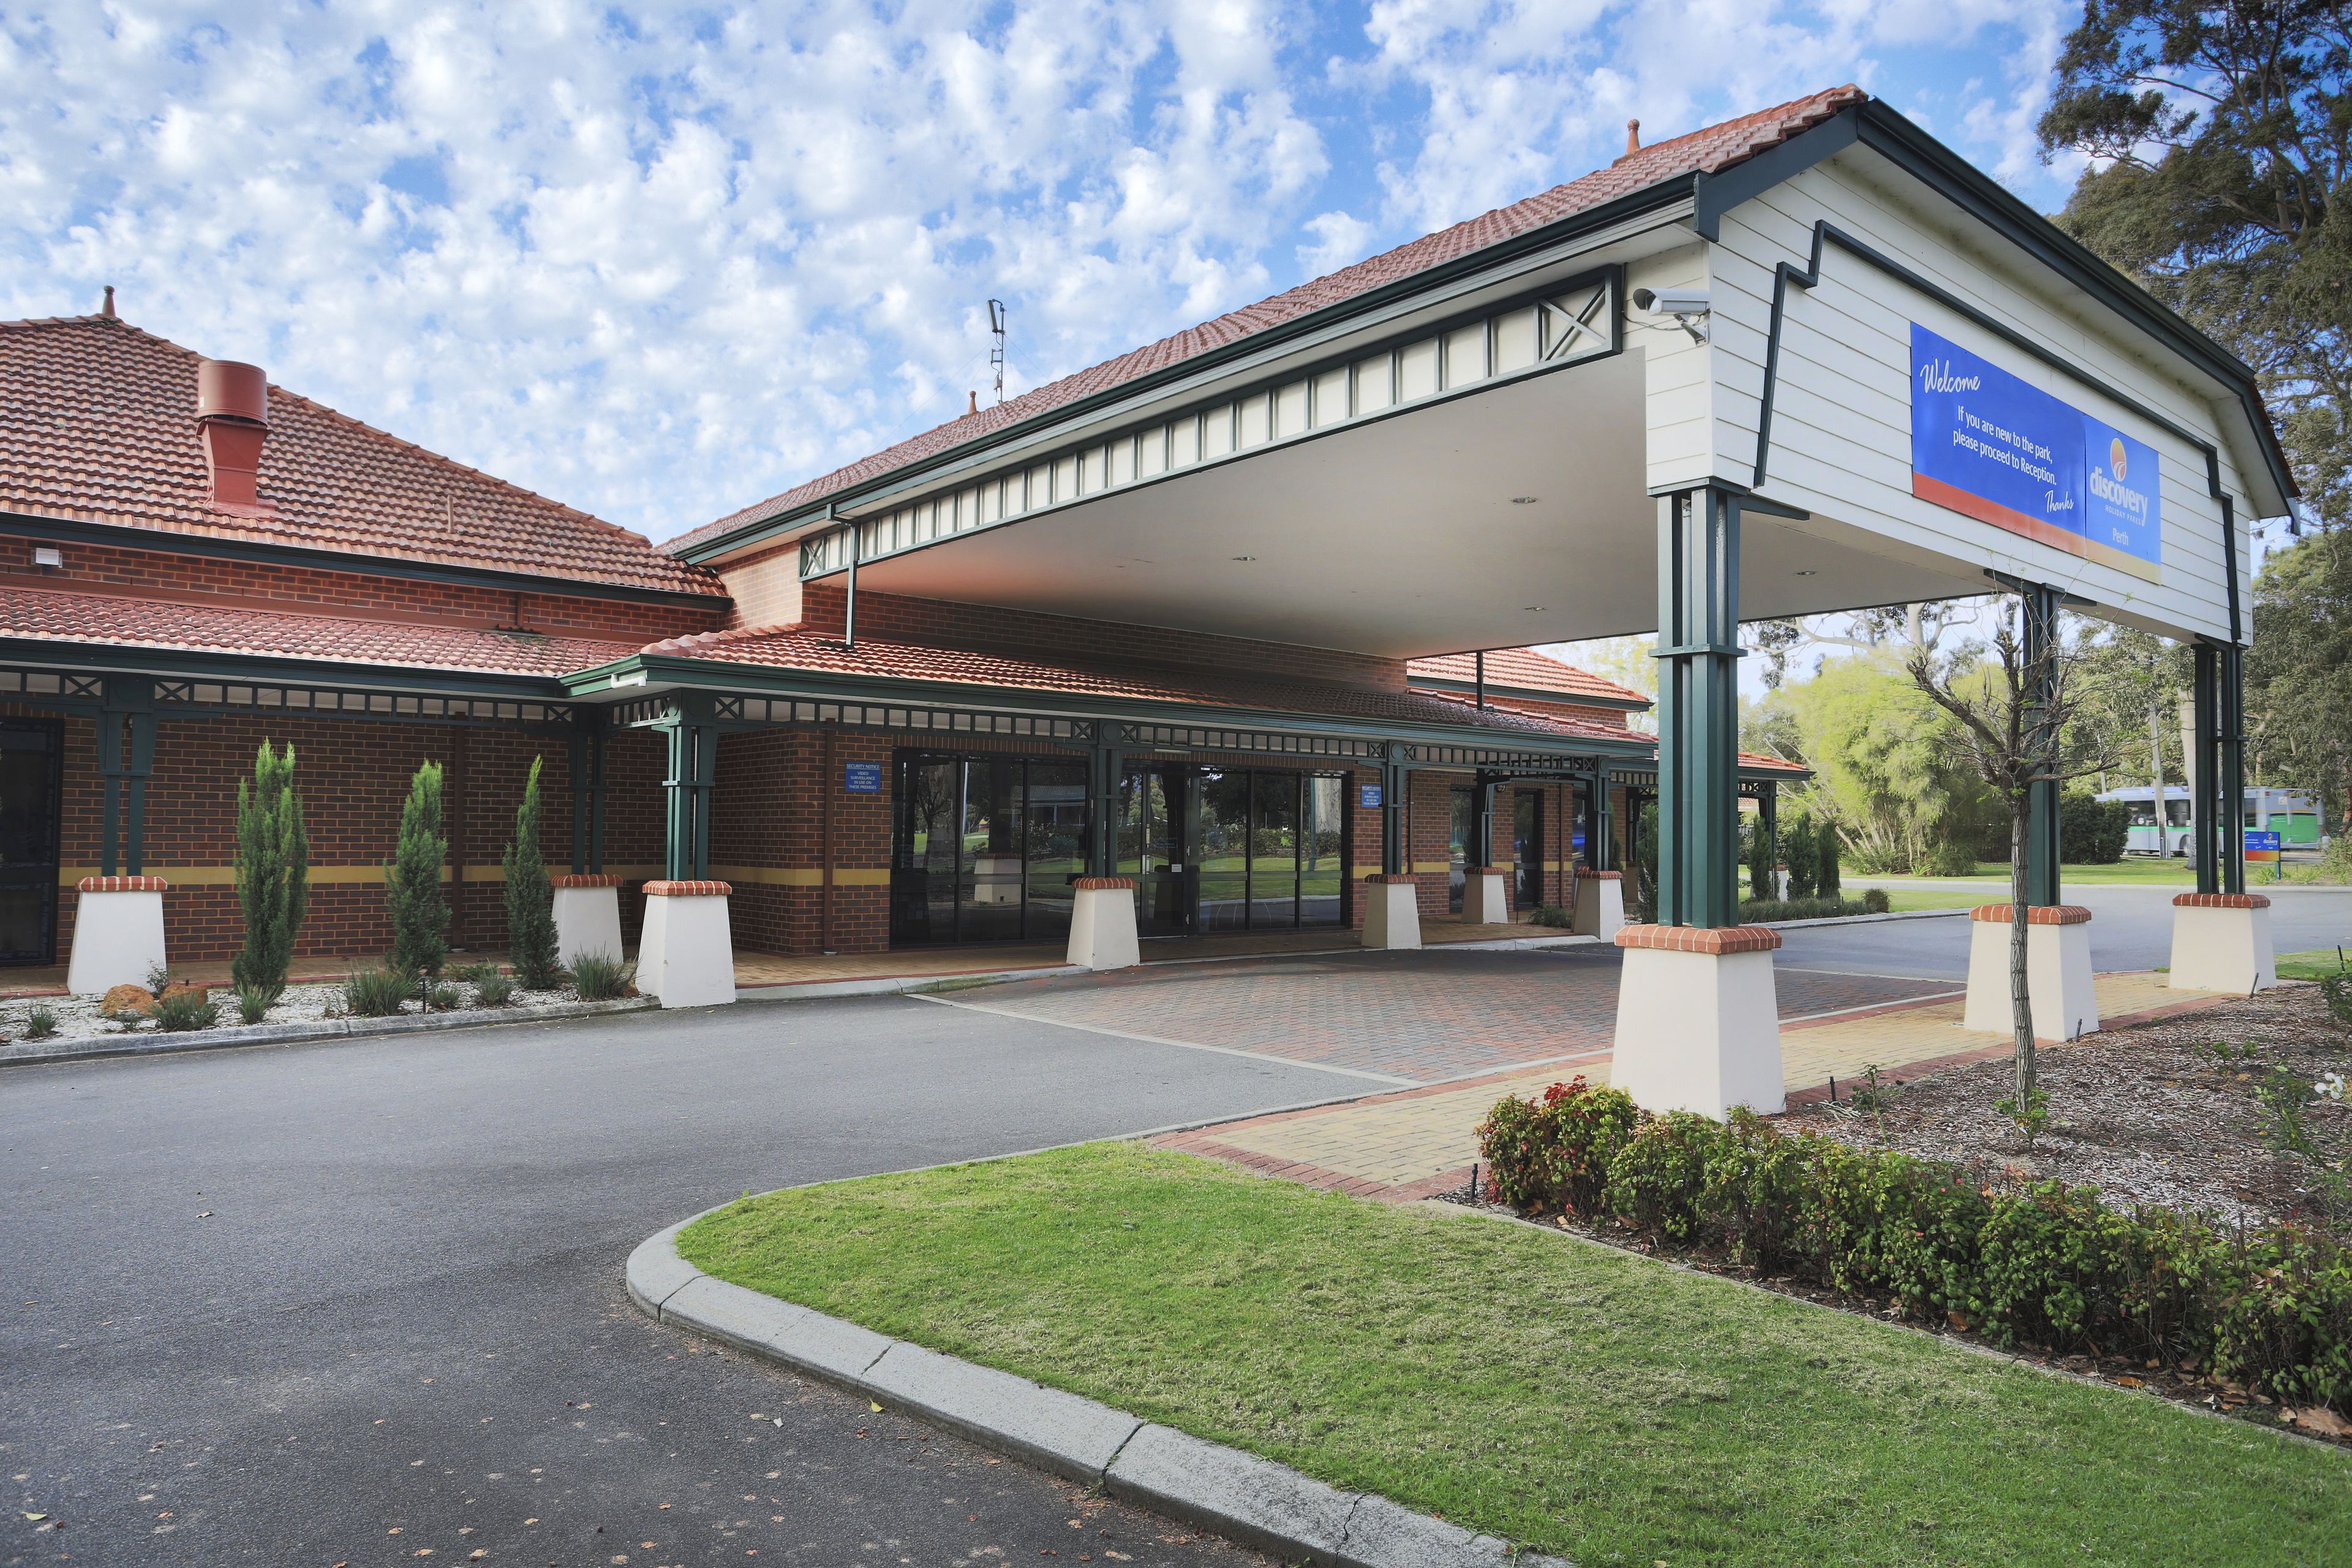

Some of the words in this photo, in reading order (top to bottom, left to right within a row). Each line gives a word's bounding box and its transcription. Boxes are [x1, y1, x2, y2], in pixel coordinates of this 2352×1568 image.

[1920, 358, 1980, 393] Welcome
[1958, 405, 1964, 421] If
[1966, 412, 1980, 428] you
[1981, 420, 1994, 435] are
[1996, 426, 2012, 443] new
[2013, 432, 2021, 448] to
[2022, 436, 2034, 454] the
[2035, 445, 2052, 464] park,
[1953, 428, 1978, 451] please
[1980, 442, 2010, 466] proceed
[2011, 453, 2019, 470] to
[2021, 457, 2057, 486] Reception.
[2045, 490, 2075, 513] Thanks
[2090, 466, 2148, 527] discovery
[2105, 504, 2126, 519] HOLIDAY
[2127, 513, 2141, 526] PARKS
[2113, 527, 2129, 546] Perth
